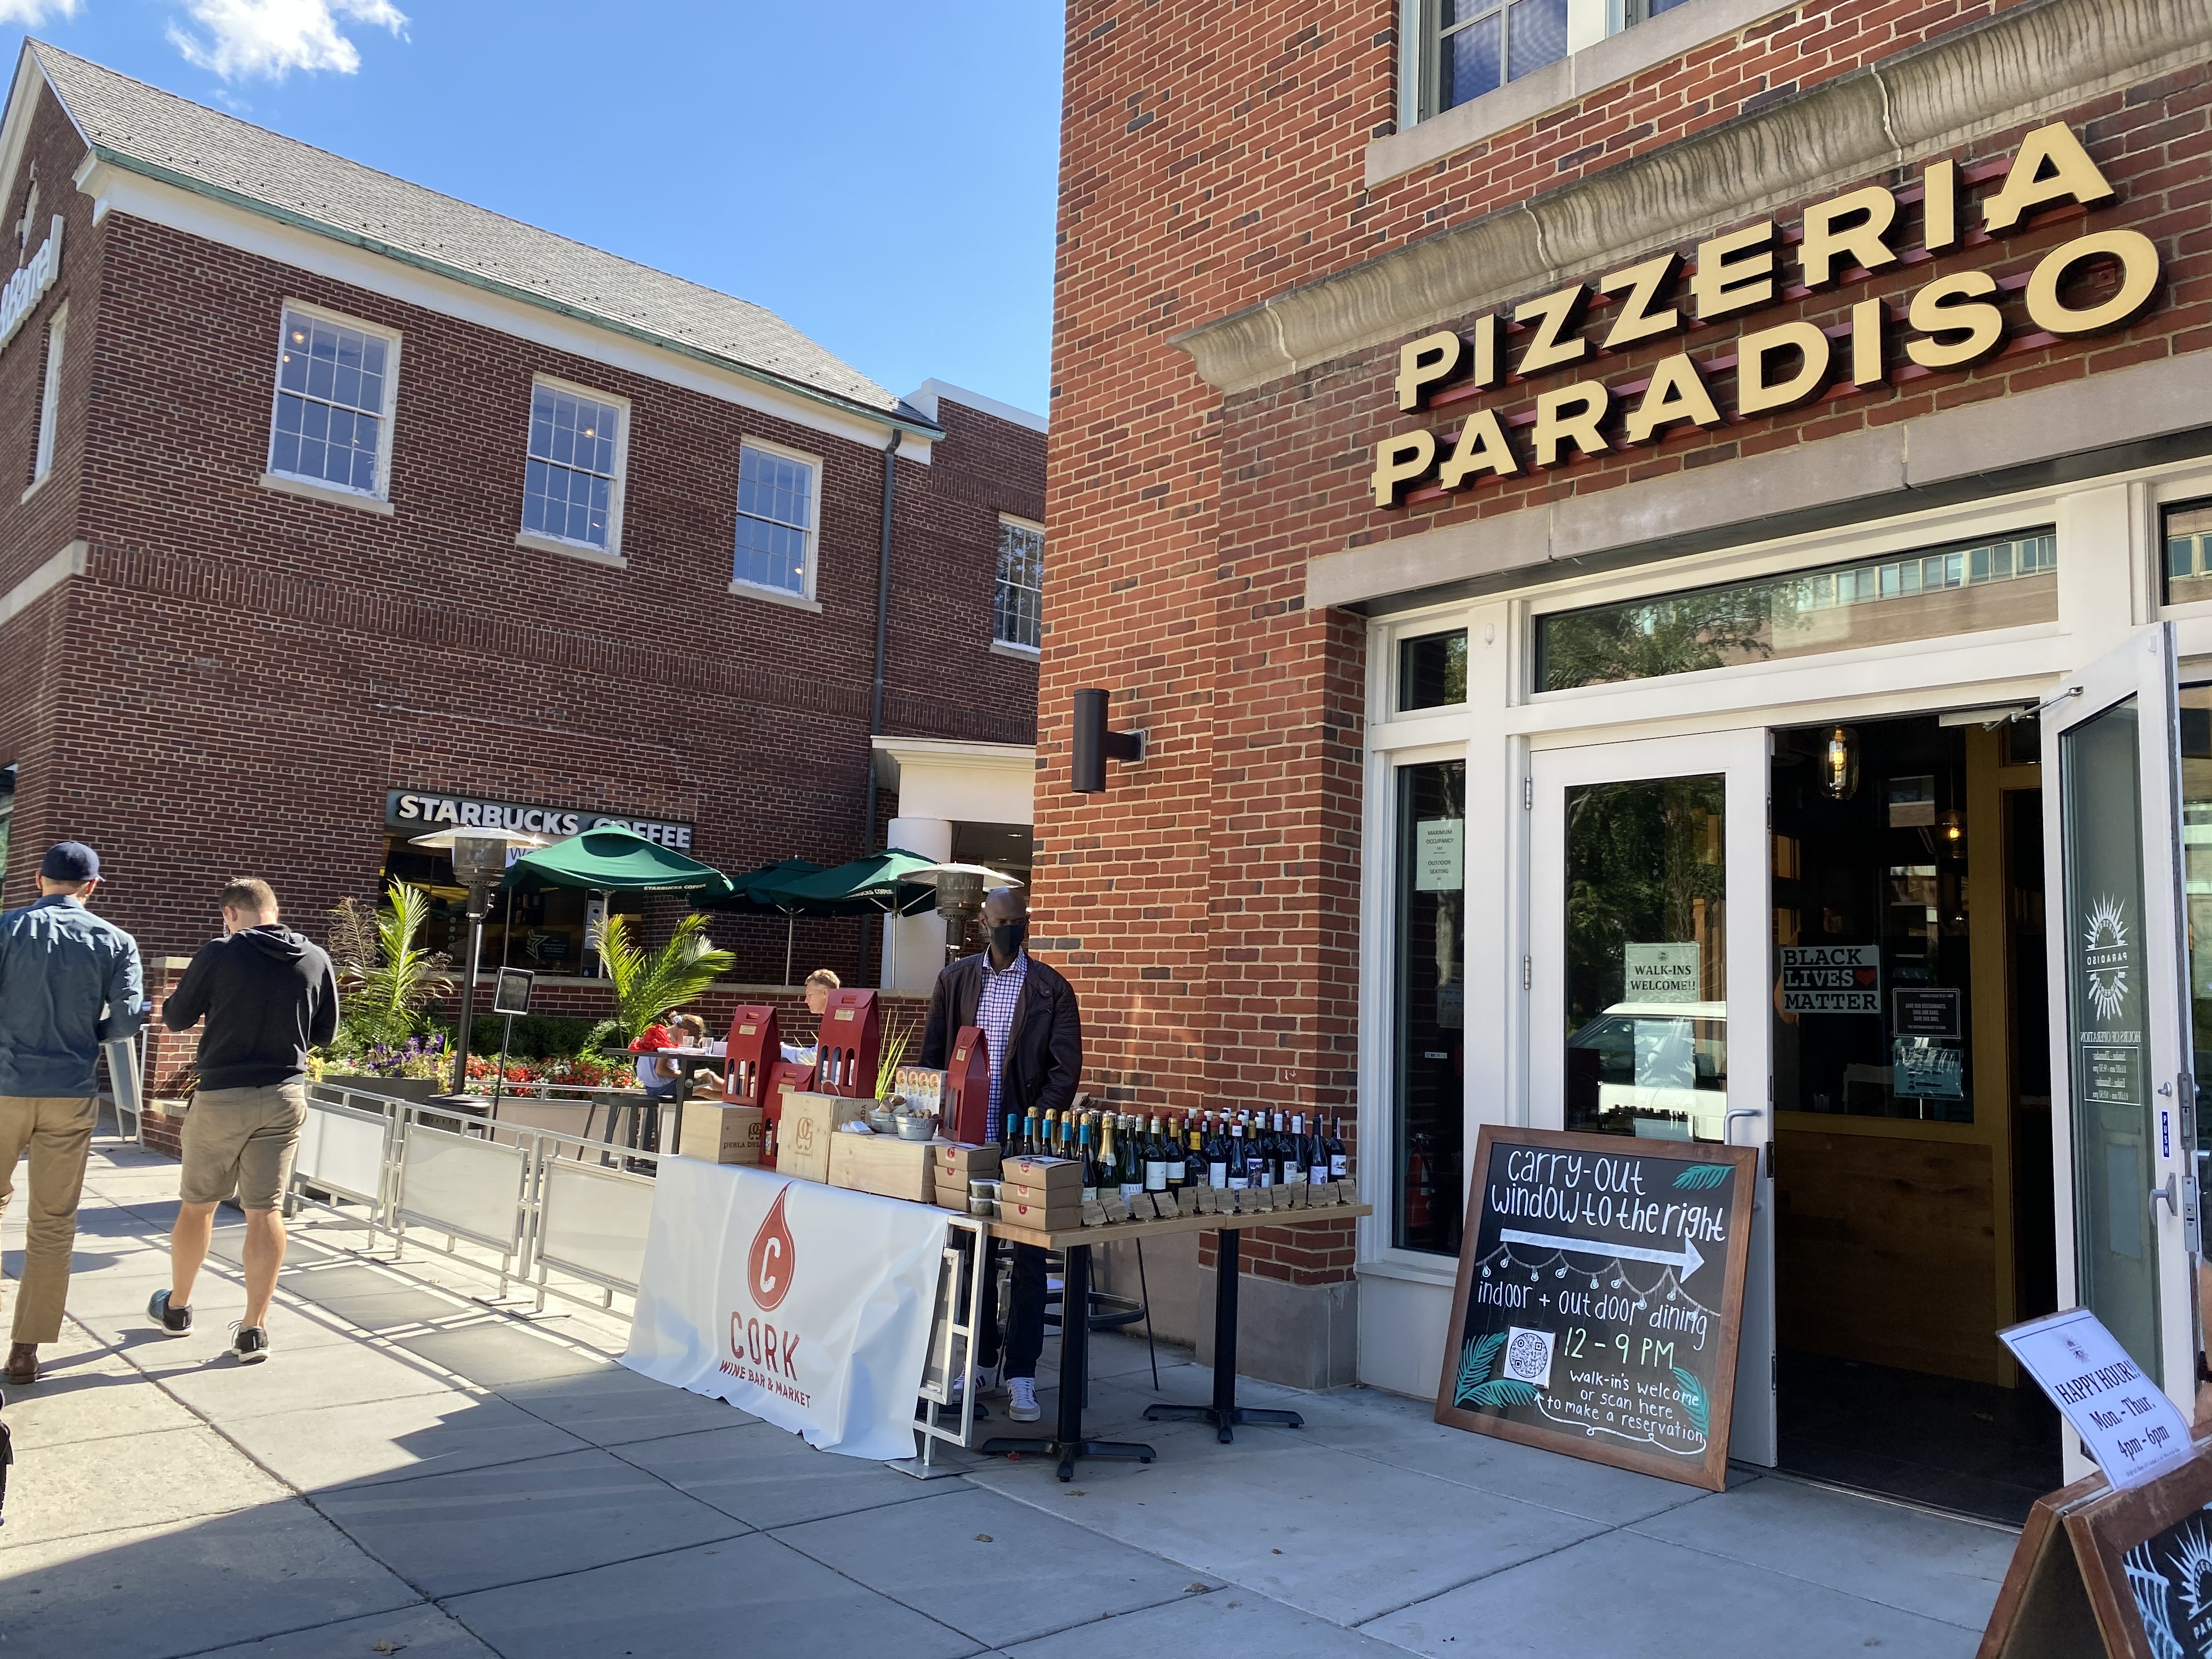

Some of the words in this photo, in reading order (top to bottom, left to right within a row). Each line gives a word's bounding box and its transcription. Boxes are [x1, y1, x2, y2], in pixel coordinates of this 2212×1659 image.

[1393, 120, 2115, 413] PIZZERIA
[1370, 229, 2159, 510] PARADISO
[399, 795, 579, 836] STARBUCKS
[1635, 965, 1691, 975] WALK-INS
[1784, 949, 1862, 966] BLACK
[1785, 969, 1854, 987] LIVES
[1630, 980, 1695, 990] WELCOME!!
[1785, 994, 1877, 1009] MATTER
[1508, 1150, 1646, 1195] carry-out
[1492, 1183, 1580, 1223] window
[1582, 1193, 1612, 1227] to
[1616, 1198, 1660, 1234] the
[1661, 1203, 1726, 1242] right
[760, 1237, 781, 1293] C
[1477, 1280, 1533, 1311] indoor
[1539, 1294, 1550, 1306] +
[1559, 1290, 1639, 1325] outdoor
[1649, 1304, 1708, 1351] dining
[730, 1311, 800, 1381] CORK
[1565, 1327, 1583, 1359] 12
[1615, 1333, 1629, 1364] 9
[1640, 1338, 1674, 1369] PM
[719, 1359, 746, 1379] WINE
[748, 1369, 765, 1388] BAR
[768, 1378, 774, 1391] &
[775, 1380, 810, 1408] MARKET
[1637, 1382, 1699, 1406] welcome
[2055, 1373, 2102, 1405] HAPPY
[2095, 1360, 2141, 1390] HOUR!!
[1547, 1396, 1561, 1411] to
[1565, 1401, 1599, 1420] make
[1606, 1412, 1615, 1422] a
[1621, 1414, 1704, 1443] reservation
[1580, 1389, 1595, 1401] or
[1600, 1393, 1632, 1410] scan
[1639, 1398, 1673, 1419] here
[2089, 1411, 2123, 1431] Mon.
[2121, 1397, 2156, 1416] Thur.
[2117, 1440, 2143, 1461] 4pm
[2146, 1425, 2170, 1448] 6pm
